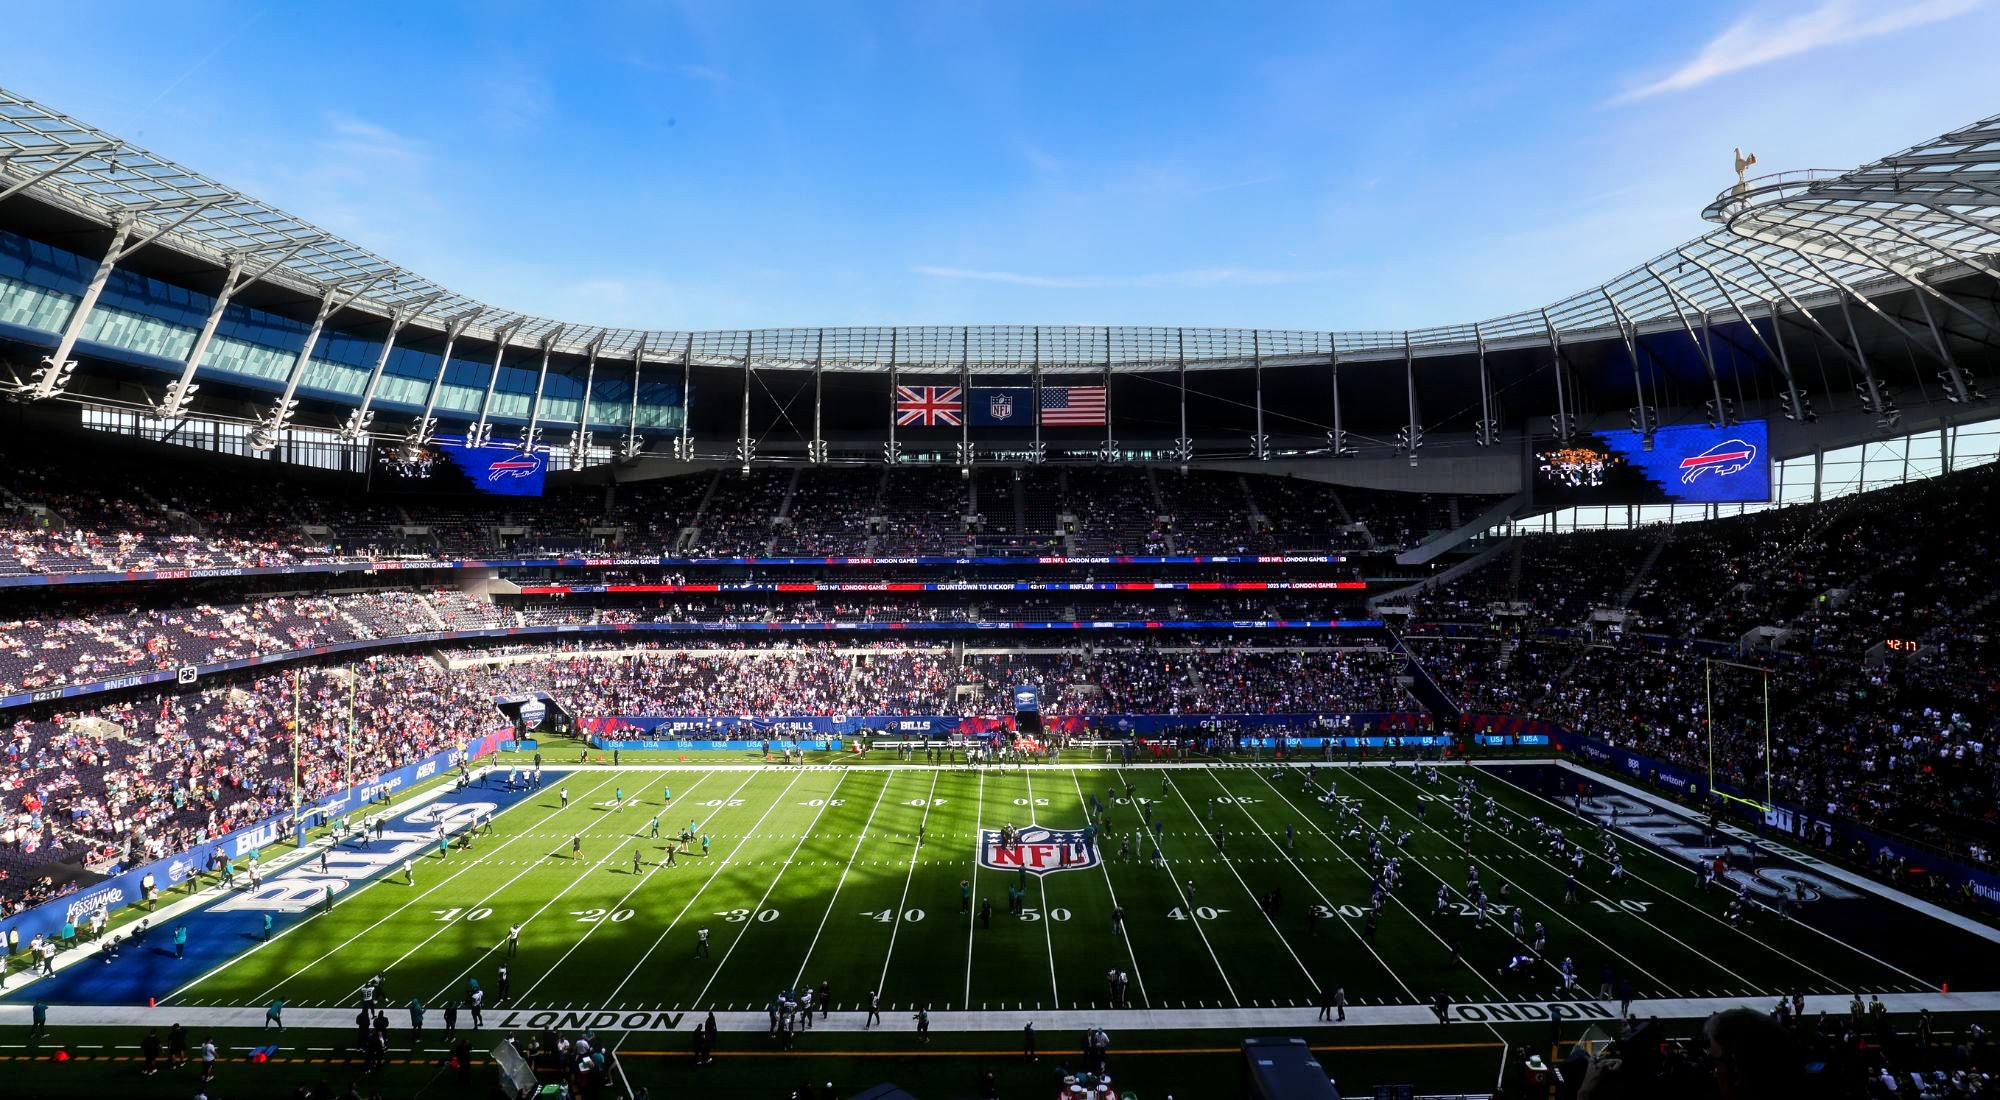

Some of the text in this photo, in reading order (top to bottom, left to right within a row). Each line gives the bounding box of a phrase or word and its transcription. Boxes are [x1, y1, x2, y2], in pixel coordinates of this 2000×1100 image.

[993, 405, 1010, 417] NFL
[156, 569, 242, 580] 2023 NFL LONDON GAMES
[1886, 639, 1917, 652] 42:17
[182, 669, 194, 681] 25
[104, 677, 142, 690] #NFLUK
[33, 690, 63, 701] 42:17
[900, 721, 931, 731] BILLS
[1660, 773, 1685, 788] verizon
[706, 799, 746, 807] 20
[808, 799, 846, 807] 30
[1013, 798, 1049, 806] 50
[204, 802, 497, 913] BILLS
[1590, 899, 1649, 913] 10
[435, 908, 493, 921] 10
[575, 908, 635, 922] 20
[724, 908, 780, 923] 30
[872, 908, 926, 922] 40
[1019, 908, 1072, 922] 50
[1166, 906, 1218, 921] 40
[498, 1011, 685, 1030] LONDON
